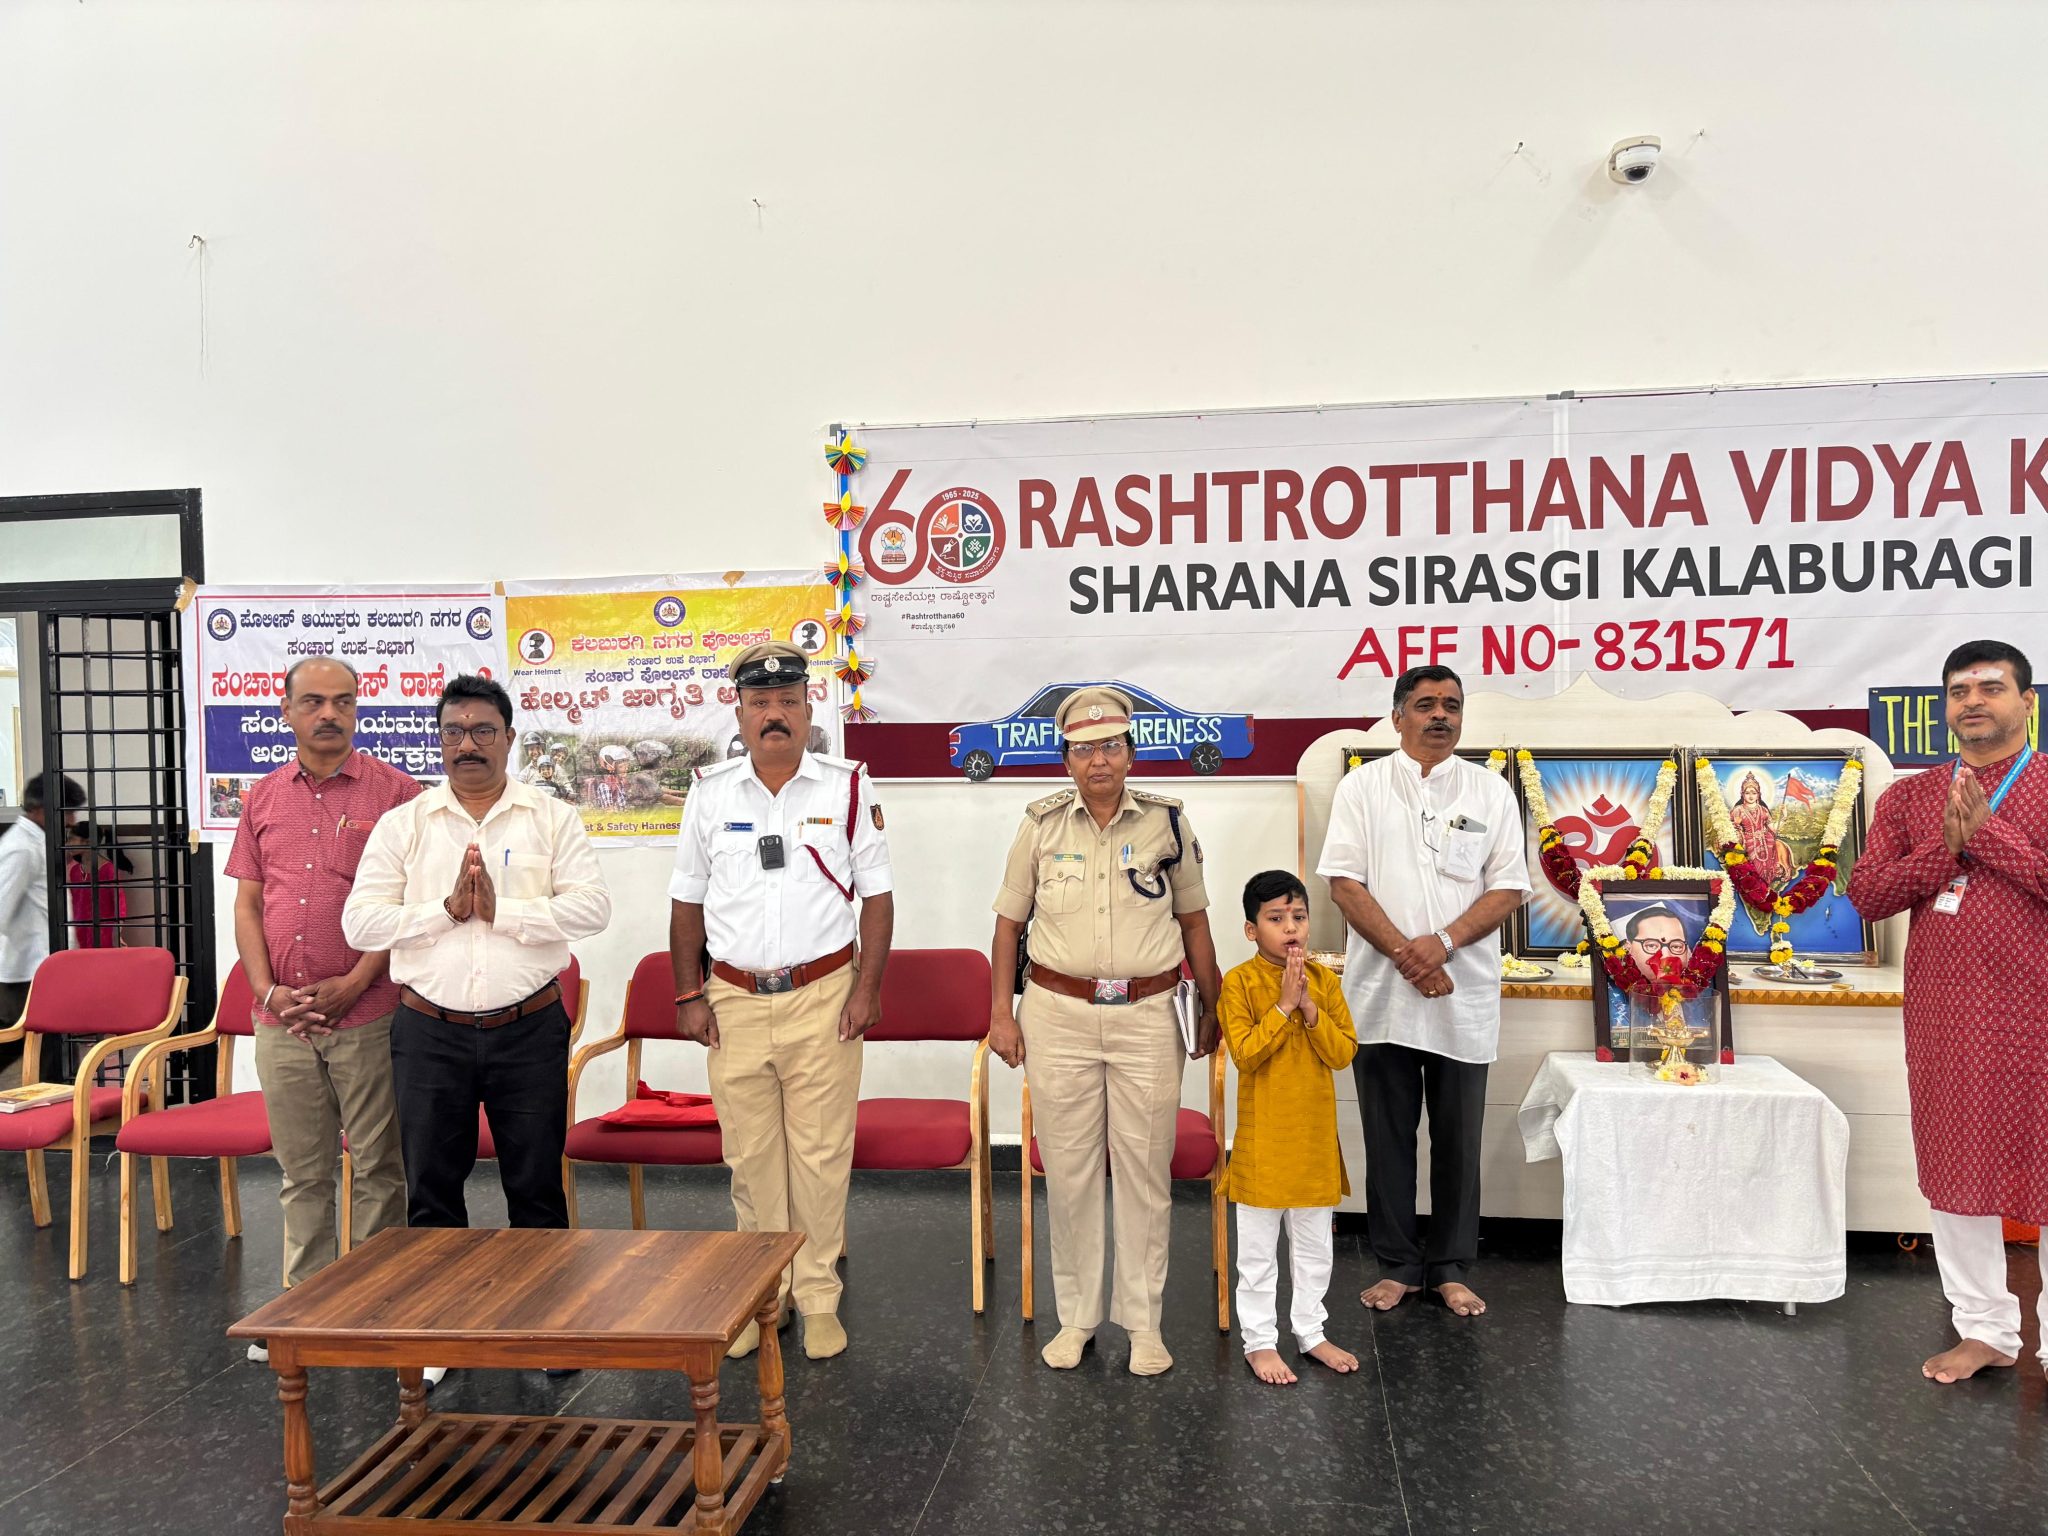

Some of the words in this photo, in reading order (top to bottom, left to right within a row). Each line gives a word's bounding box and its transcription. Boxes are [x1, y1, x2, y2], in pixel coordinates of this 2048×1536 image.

[1019, 453, 1708, 549] RASHTROTTHANA
[1729, 440, 1983, 525] VIDYA
[1070, 558, 1362, 614] SHARANA
[1368, 550, 1599, 607] SIRASGI
[1623, 535, 2032, 598] KALABURAGI
[240, 609, 295, 628] ಪೊಲೀಸ್
[302, 608, 360, 634] ಆಯುಕ್ತರು
[367, 607, 423, 628] ಕಲಬುರಗಿ
[430, 607, 462, 627] ನಗರ
[901, 612, 965, 620] #Rashtrotthana60
[287, 637, 334, 656] ಸಂಚಾರ
[571, 633, 644, 651] ಕಲಬುರಗಿ
[653, 631, 693, 649] ನಗರ
[1337, 625, 1458, 680] AFF
[628, 655, 661, 666] ಸಂಚಾರ
[666, 655, 684, 665] ಉಪ
[688, 653, 716, 664] ವಿಭಾಗ
[534, 668, 562, 676] Helmet
[585, 668, 634, 683] ಸಂಚಾರ
[622, 682, 705, 720] ಜಾಗೃತಿ
[992, 722, 1065, 748] TRAFF
[1879, 695, 1939, 755] THE
[607, 822, 639, 832] Safety
[641, 822, 681, 830] Harness
